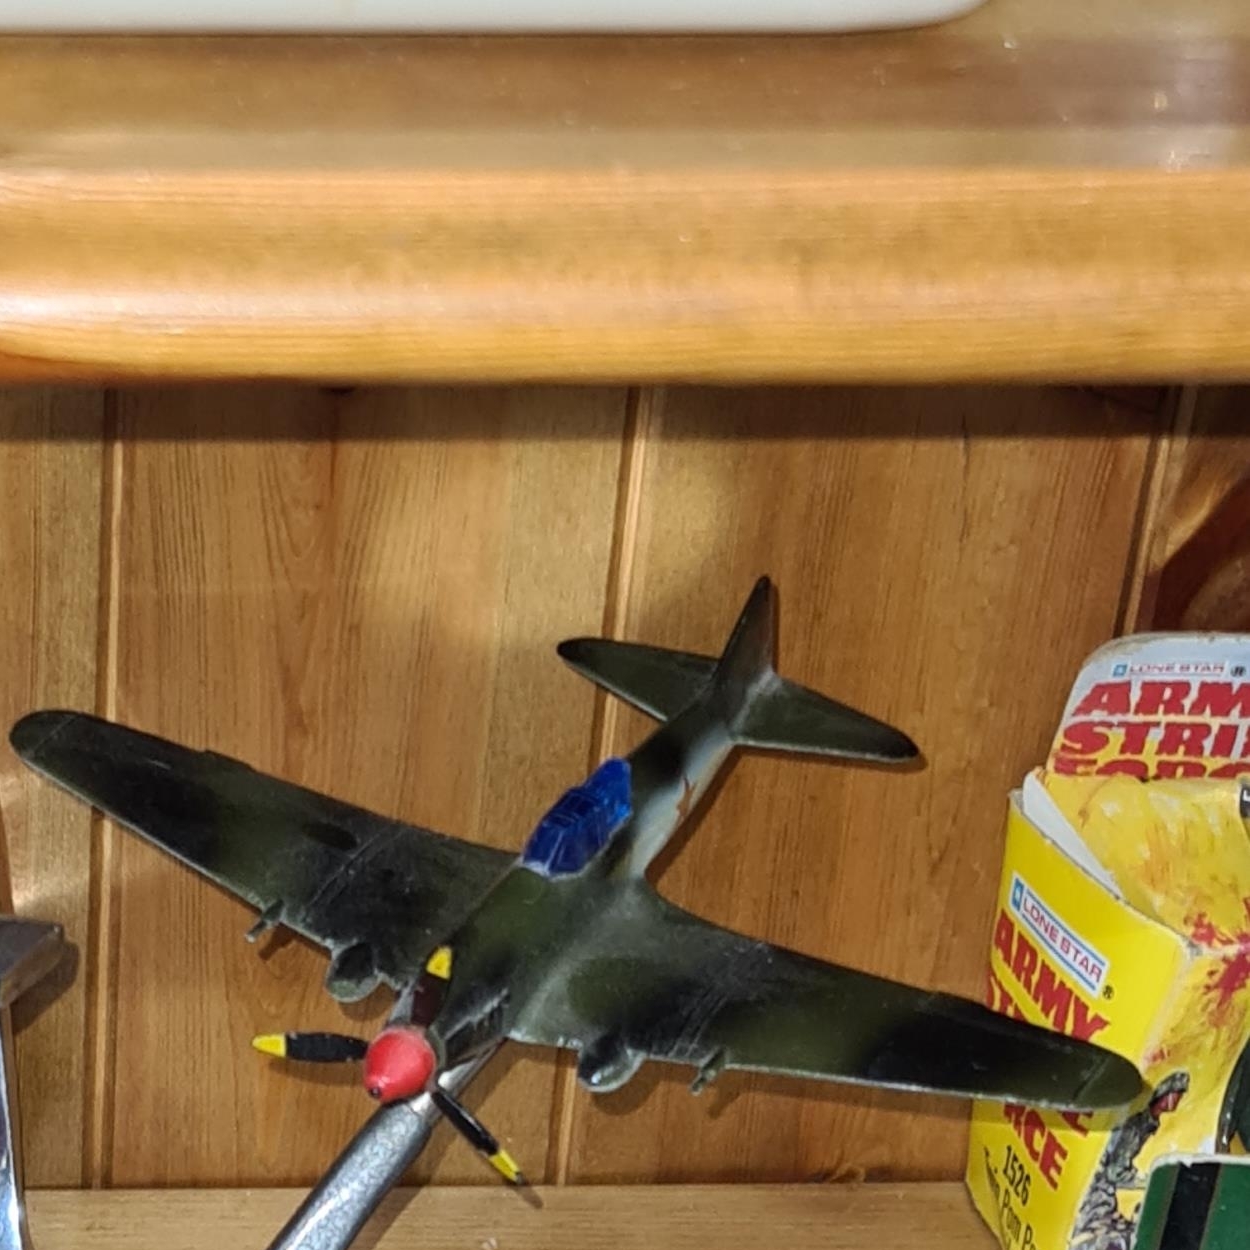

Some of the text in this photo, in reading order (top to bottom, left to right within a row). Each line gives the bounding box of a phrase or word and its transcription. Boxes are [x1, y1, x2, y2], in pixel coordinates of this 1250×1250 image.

[1072, 680, 1250, 718] ARM
[1058, 720, 1250, 758] STRI
[994, 908, 1110, 1042] ARMY
[1023, 897, 1103, 983] LONE STAR
[1003, 1102, 1069, 1192] RCE
[1003, 1145, 1031, 1207] 1526
